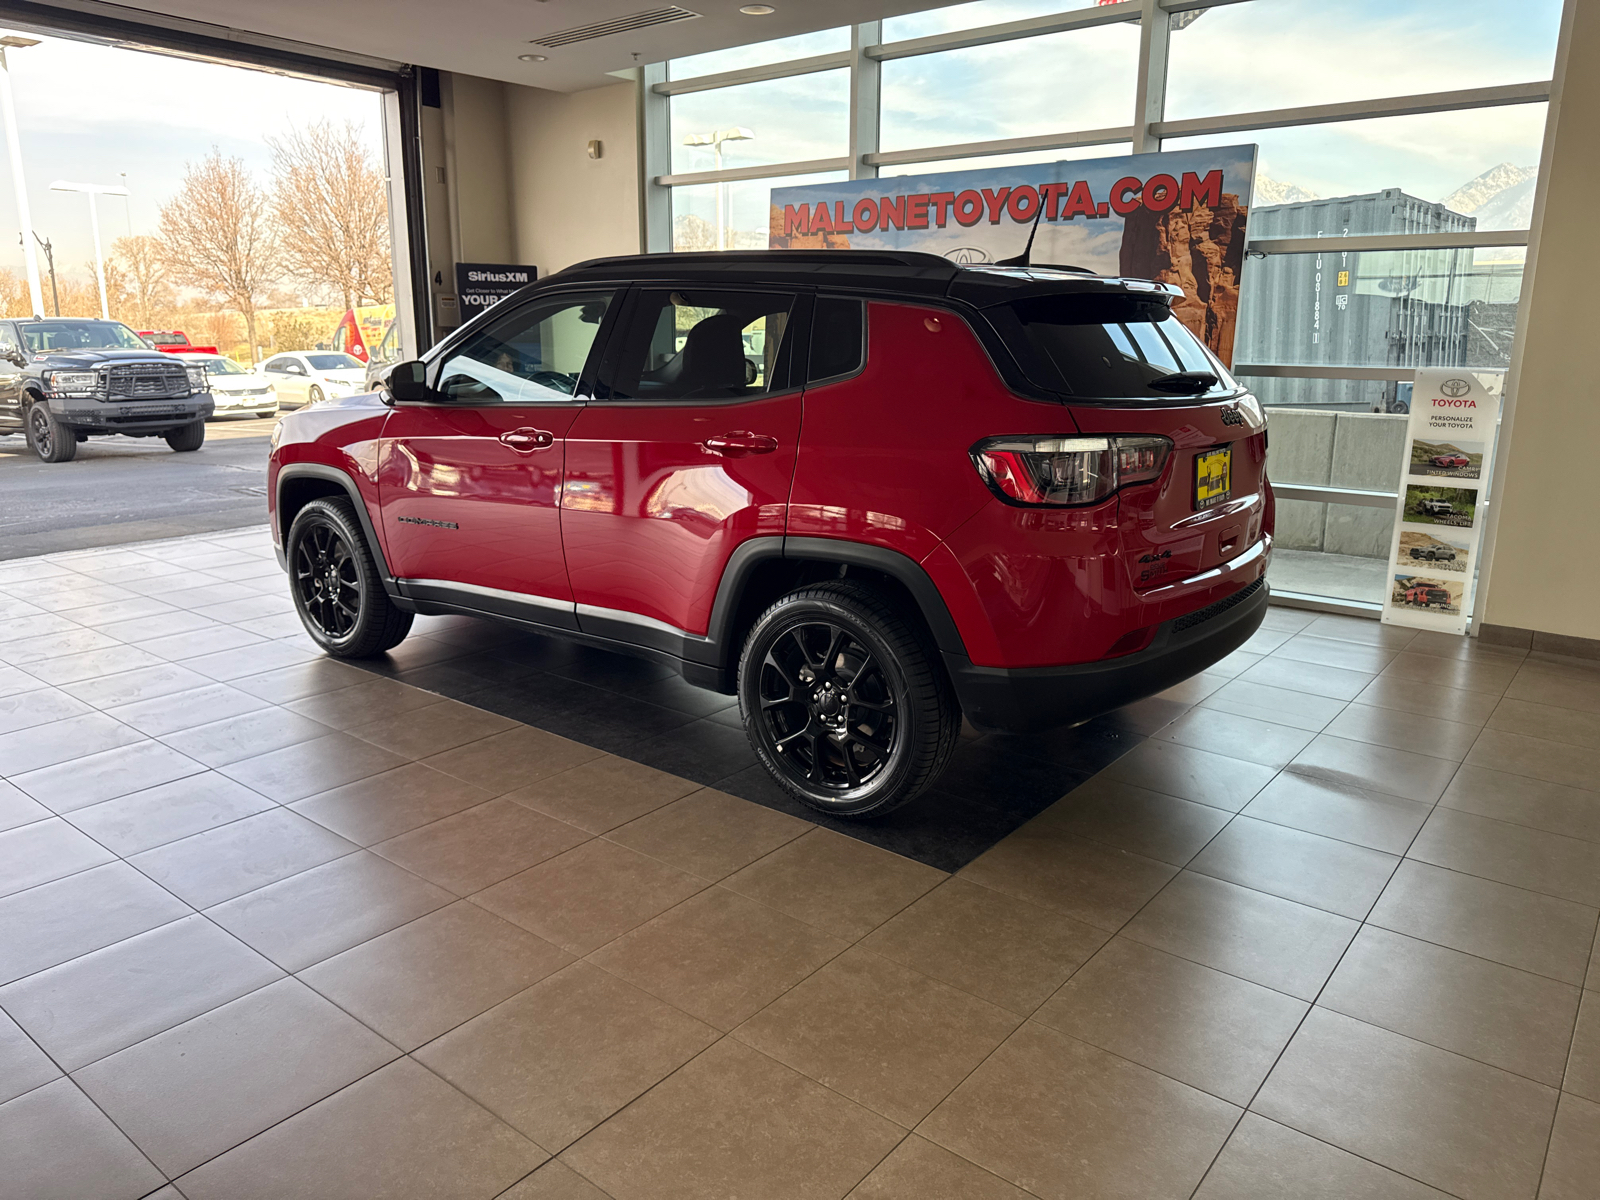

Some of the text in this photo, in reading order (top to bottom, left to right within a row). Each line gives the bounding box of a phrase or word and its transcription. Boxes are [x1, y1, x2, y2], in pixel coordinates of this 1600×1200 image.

[784, 169, 1224, 237] MALONETOYOTA.COM
[434, 270, 443, 286] 4
[467, 271, 528, 283] SiriusXM
[462, 294, 499, 305] YOUR
[1431, 398, 1477, 409] TOYOTA
[1220, 406, 1244, 427] Jeep
[1430, 415, 1473, 423] PERSONALIZE
[1447, 471, 1479, 479] WINDOWS
[1446, 513, 1472, 521] TACOMA
